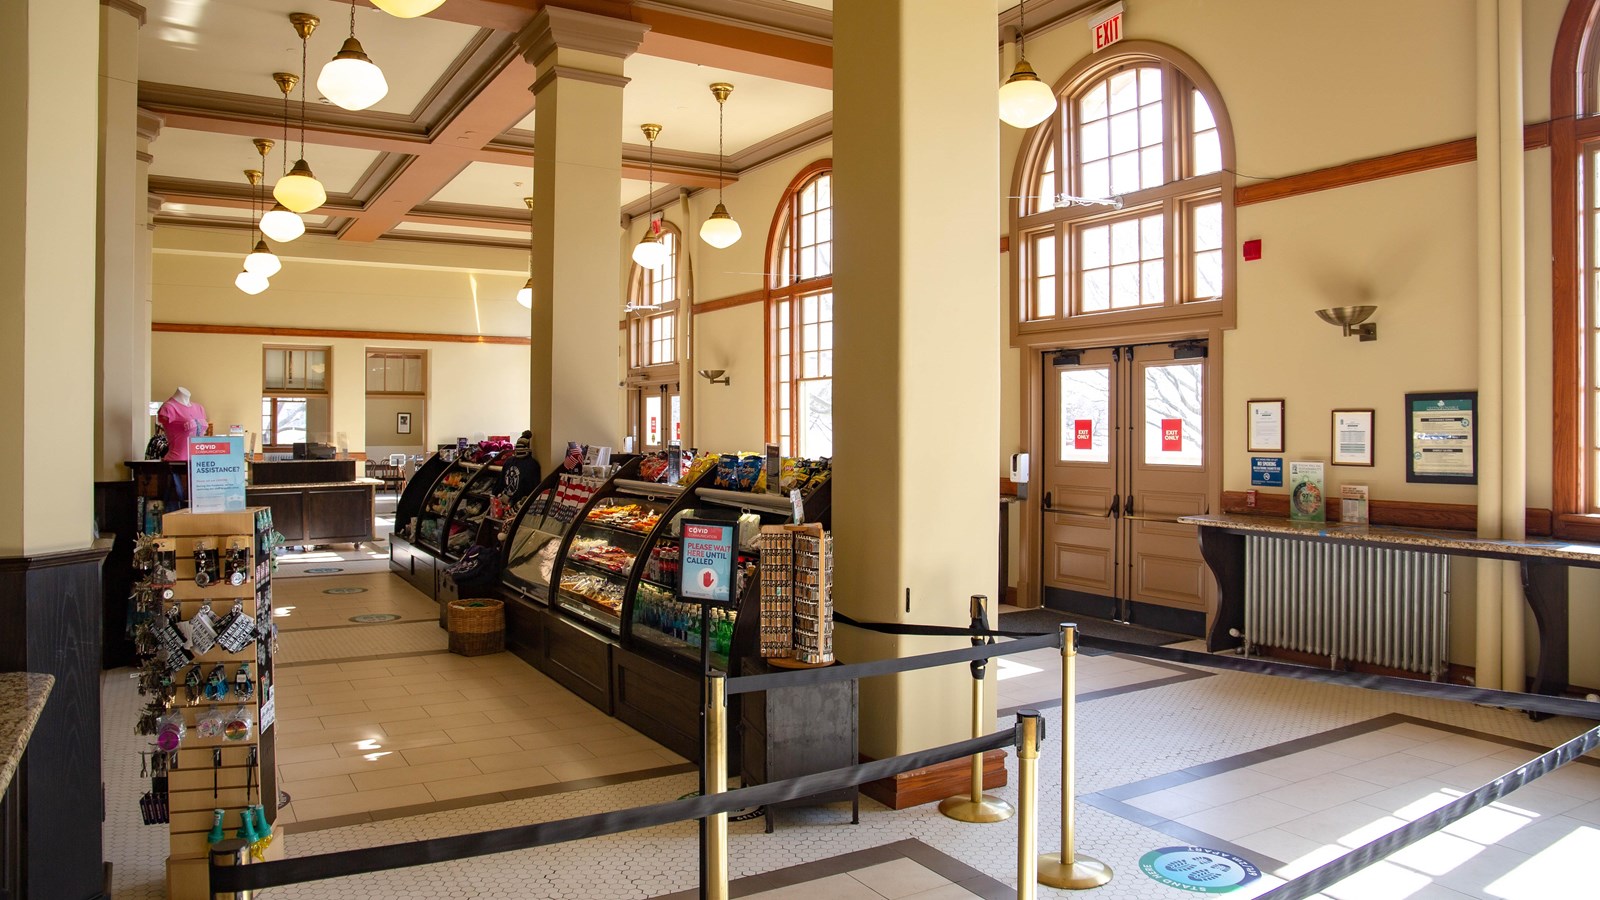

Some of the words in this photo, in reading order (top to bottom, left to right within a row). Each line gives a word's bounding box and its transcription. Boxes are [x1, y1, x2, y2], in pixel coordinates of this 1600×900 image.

[1096, 16, 1119, 49] EXIT
[686, 557, 713, 565] CALLED
[1188, 847, 1229, 857] APART
[1143, 864, 1162, 879] HERE
[1163, 880, 1206, 892] STAND
